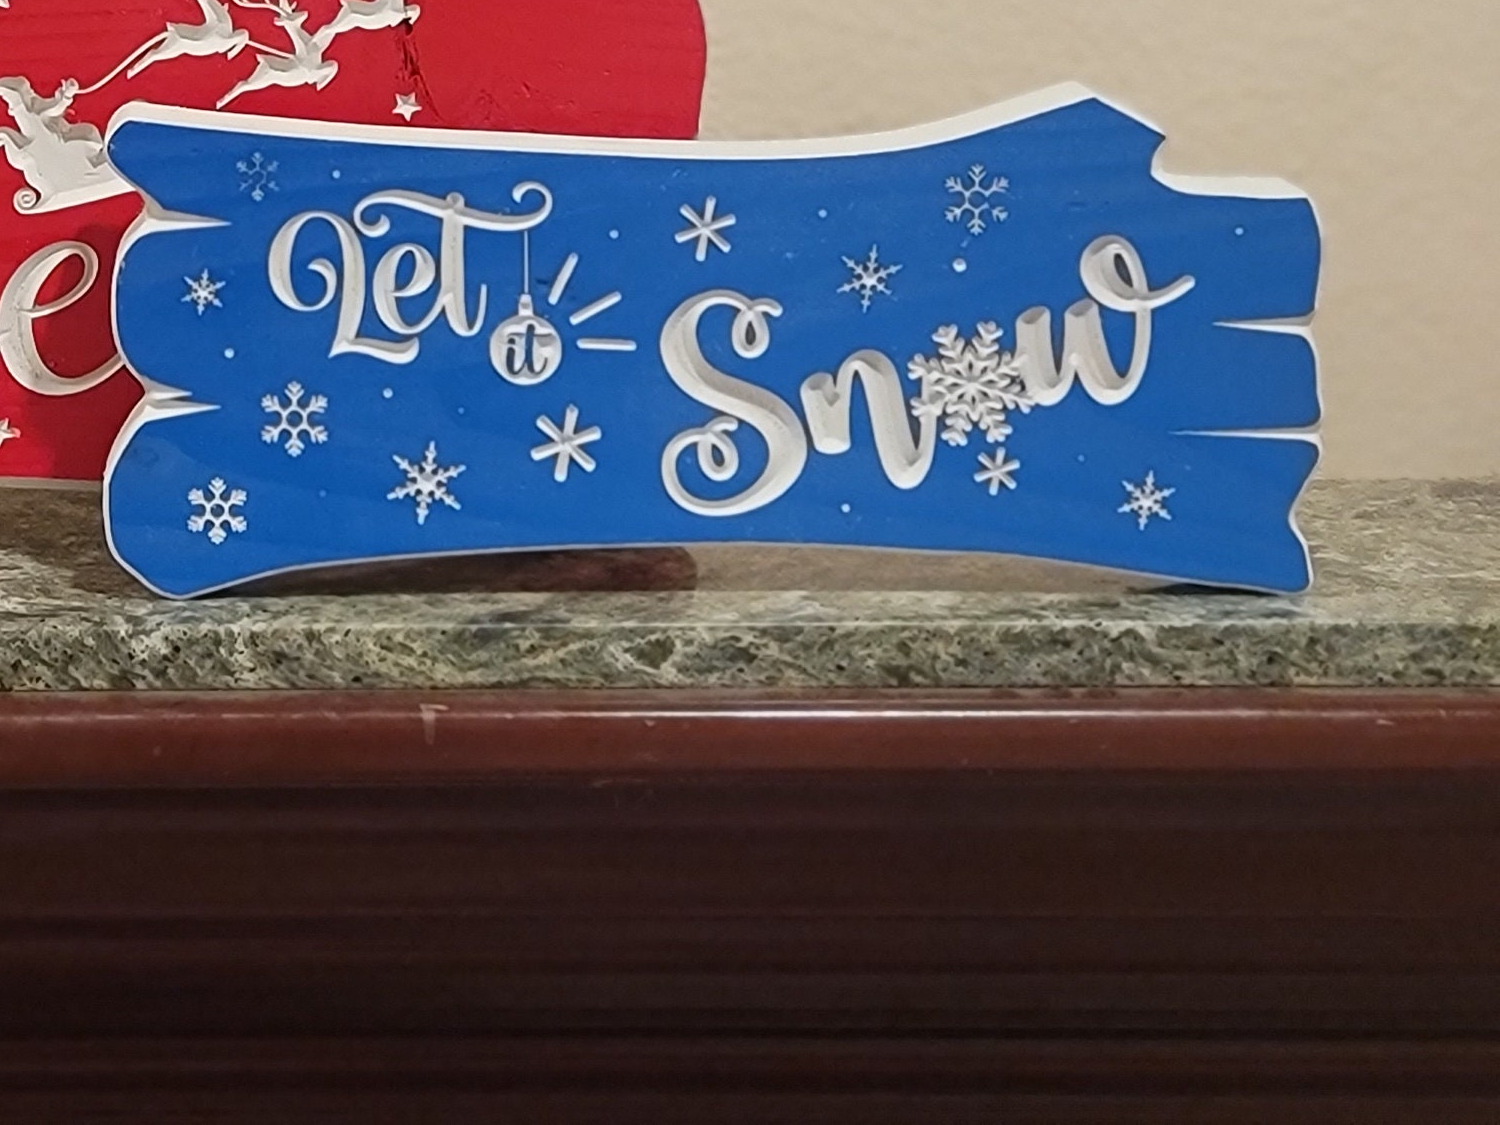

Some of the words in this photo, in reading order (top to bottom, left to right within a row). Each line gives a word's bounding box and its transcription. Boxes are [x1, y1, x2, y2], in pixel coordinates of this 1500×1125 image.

[267, 181, 553, 364] Let
[504, 323, 550, 376] it
[660, 235, 1197, 517] Snow
